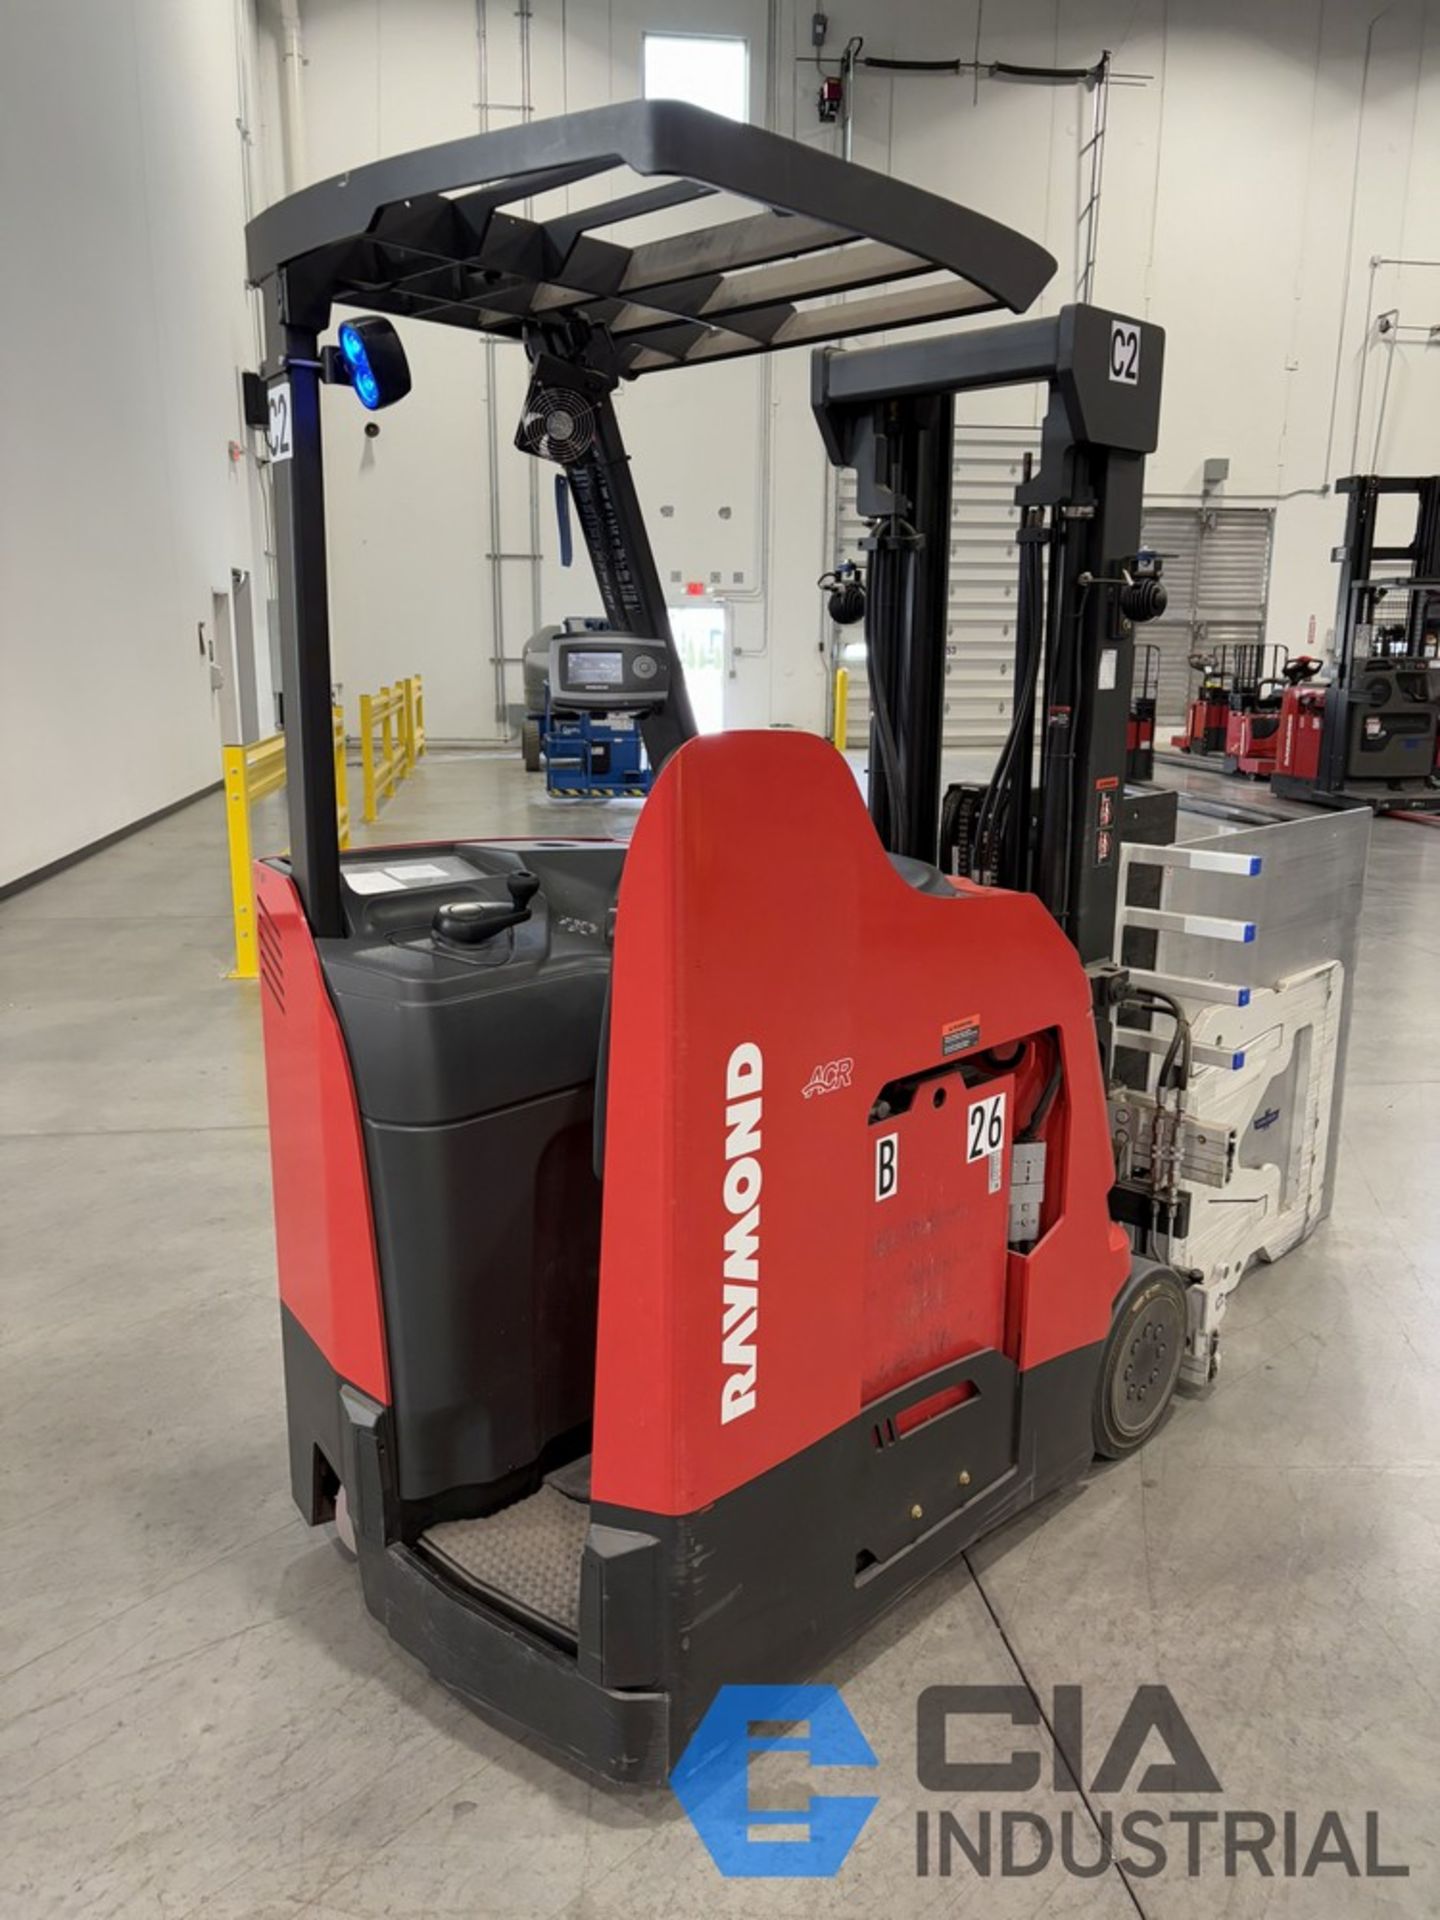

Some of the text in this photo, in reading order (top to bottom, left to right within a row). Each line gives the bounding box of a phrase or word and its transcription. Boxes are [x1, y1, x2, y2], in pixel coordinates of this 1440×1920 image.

[1112, 328, 1138, 380] C2
[801, 1057, 854, 1099] ACR
[969, 1096, 1002, 1161] 26
[878, 1139, 895, 1197] B
[721, 1042, 763, 1425] RAYMOND
